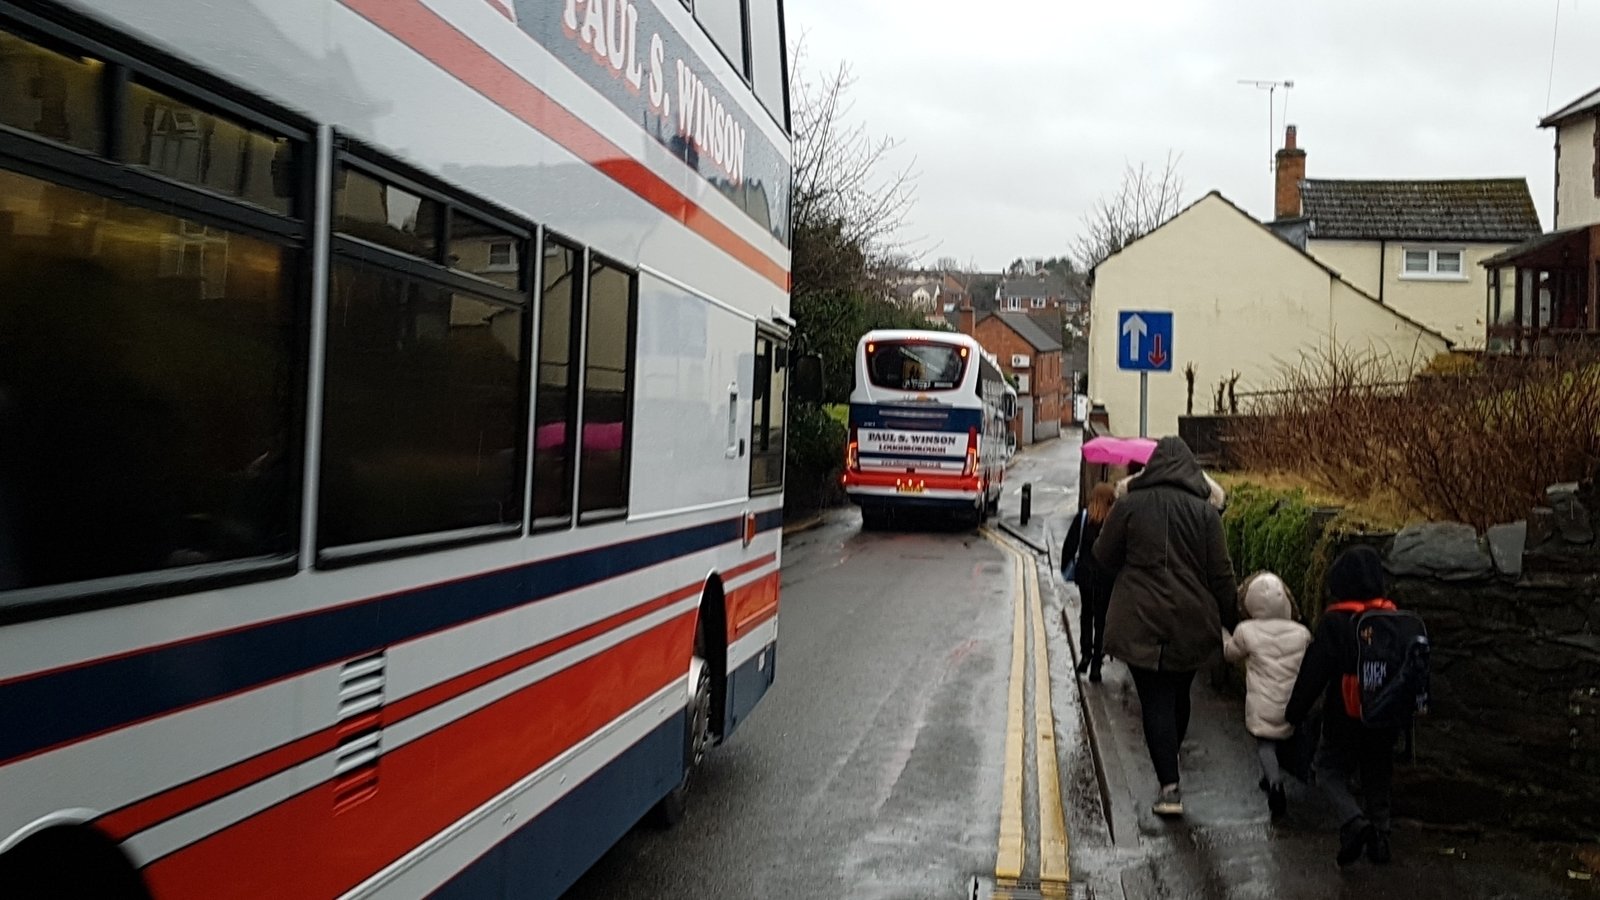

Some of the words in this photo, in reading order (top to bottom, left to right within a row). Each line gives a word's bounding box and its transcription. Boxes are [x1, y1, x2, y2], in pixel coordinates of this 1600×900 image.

[650, 33, 670, 117] S.
[676, 58, 745, 185] WINSON
[868, 432, 897, 443] PAUL
[898, 434, 908, 443] S.
[910, 434, 956, 445] WINSON
